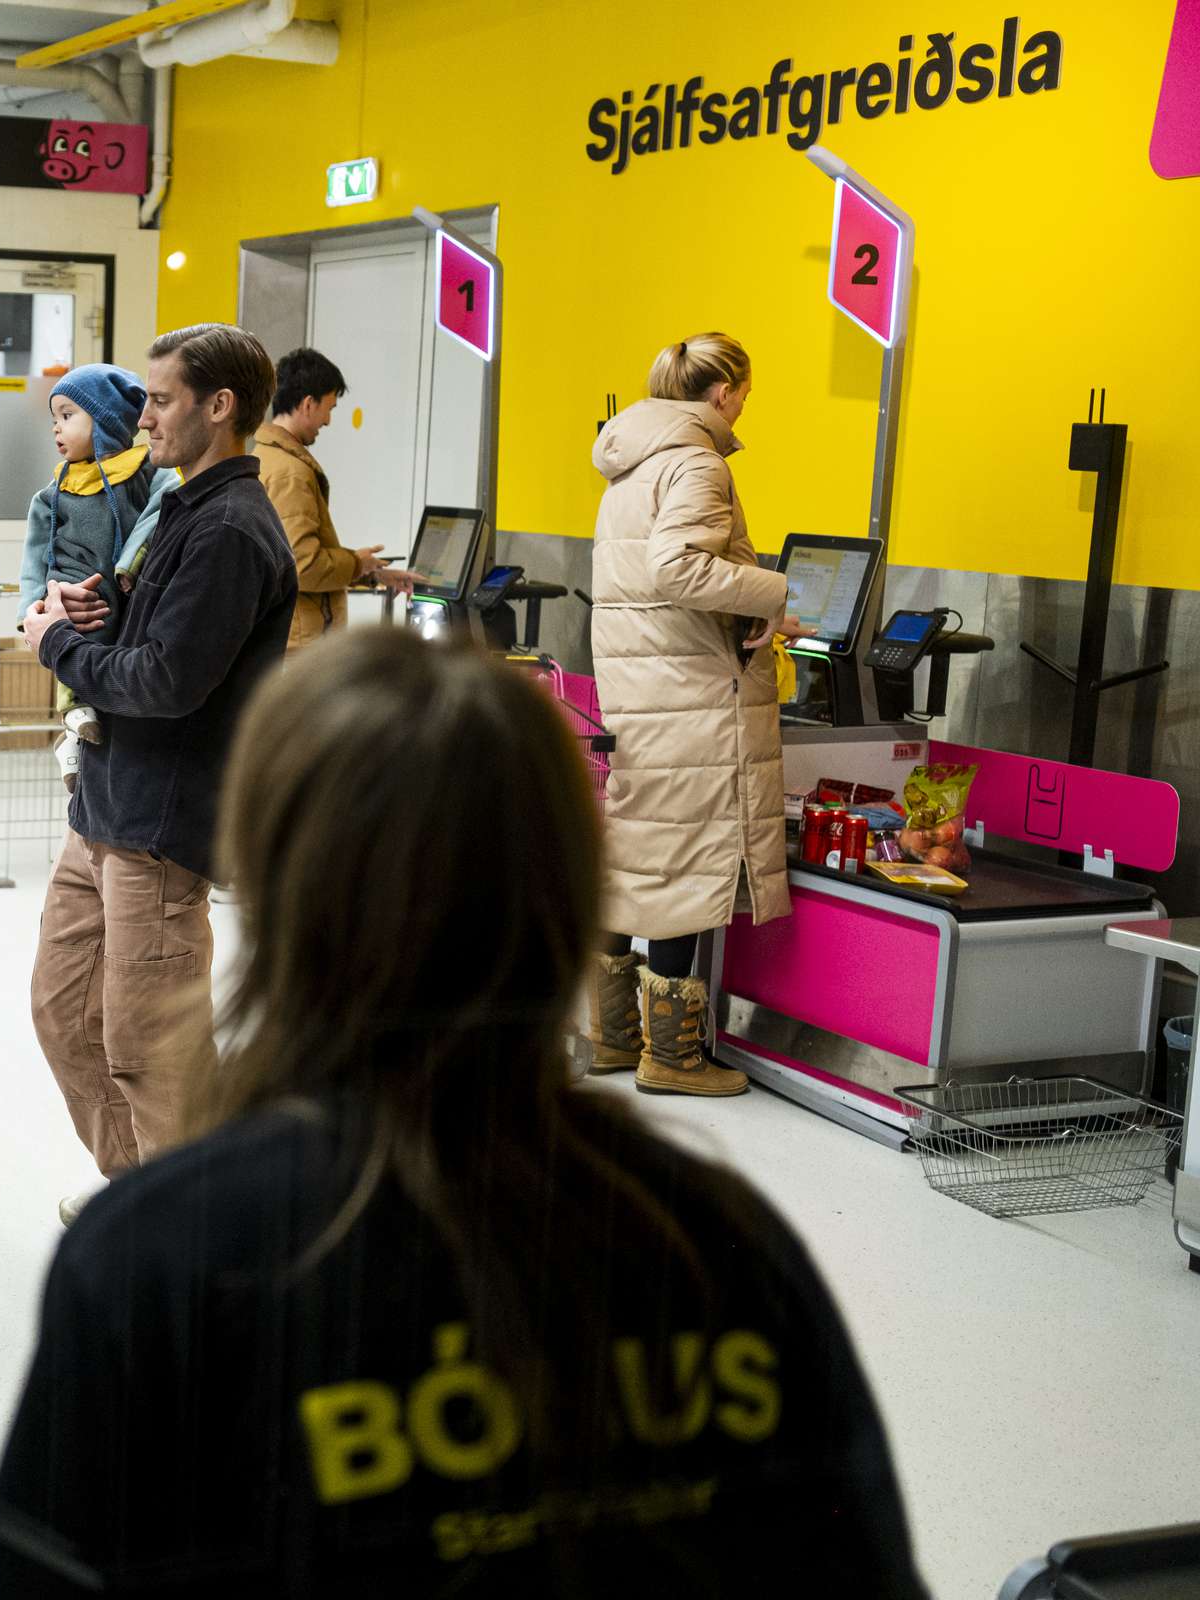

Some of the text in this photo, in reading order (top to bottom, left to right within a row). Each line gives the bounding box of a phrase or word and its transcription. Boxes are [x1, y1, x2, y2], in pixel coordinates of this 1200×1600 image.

[586, 16, 1062, 175] Sjálfsafgreiðsla
[457, 279, 475, 312] 1
[851, 243, 880, 285] 2
[297, 1318, 783, 1506] BÓUS
